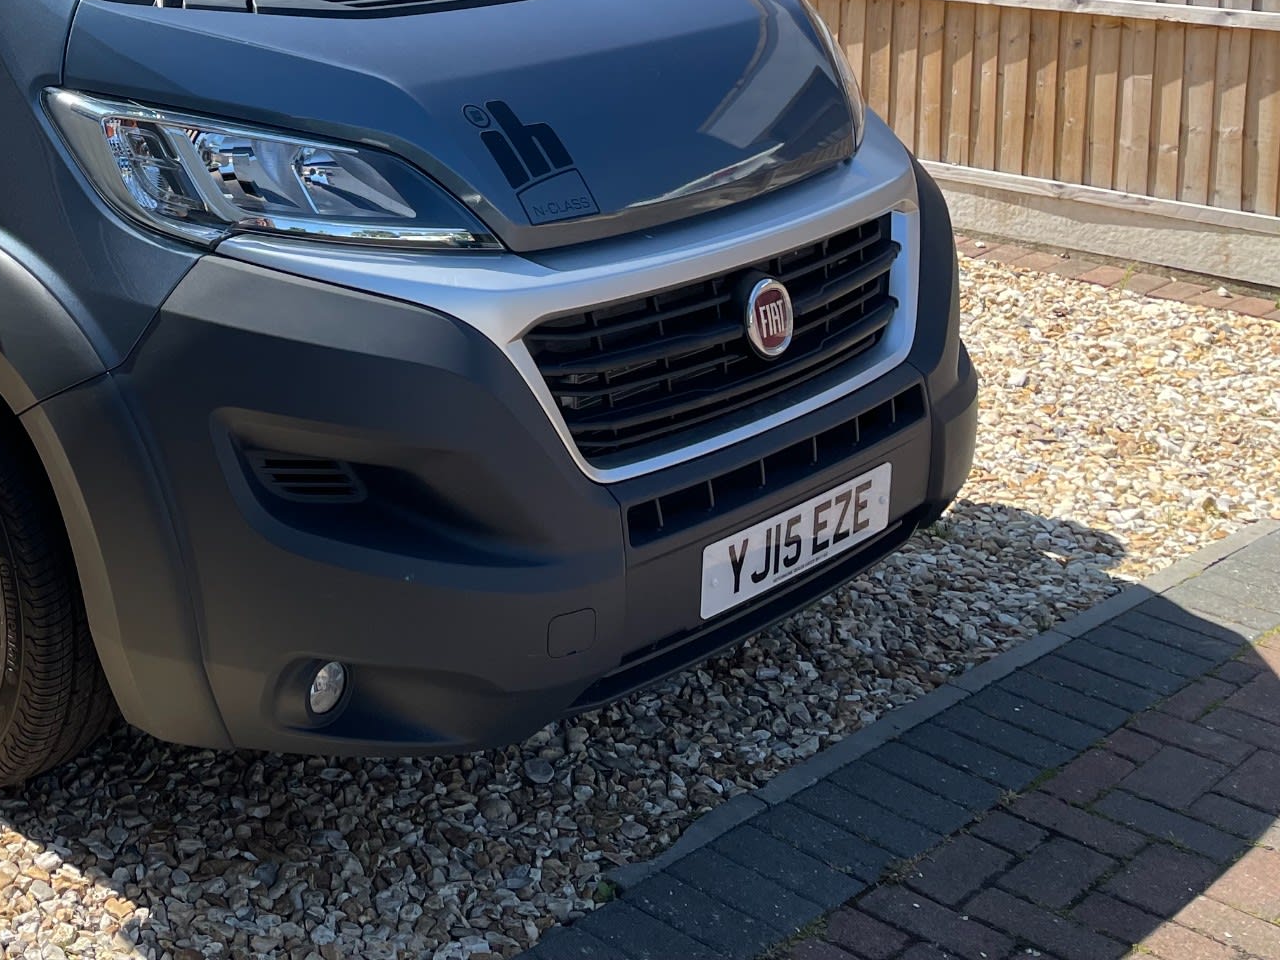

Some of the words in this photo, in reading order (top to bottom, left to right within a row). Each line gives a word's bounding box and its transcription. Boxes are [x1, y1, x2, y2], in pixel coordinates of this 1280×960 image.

[532, 196, 591, 218] N-CLASS
[759, 299, 786, 339] FIAT
[728, 514, 802, 594] YJ15
[811, 479, 873, 557] EZE
